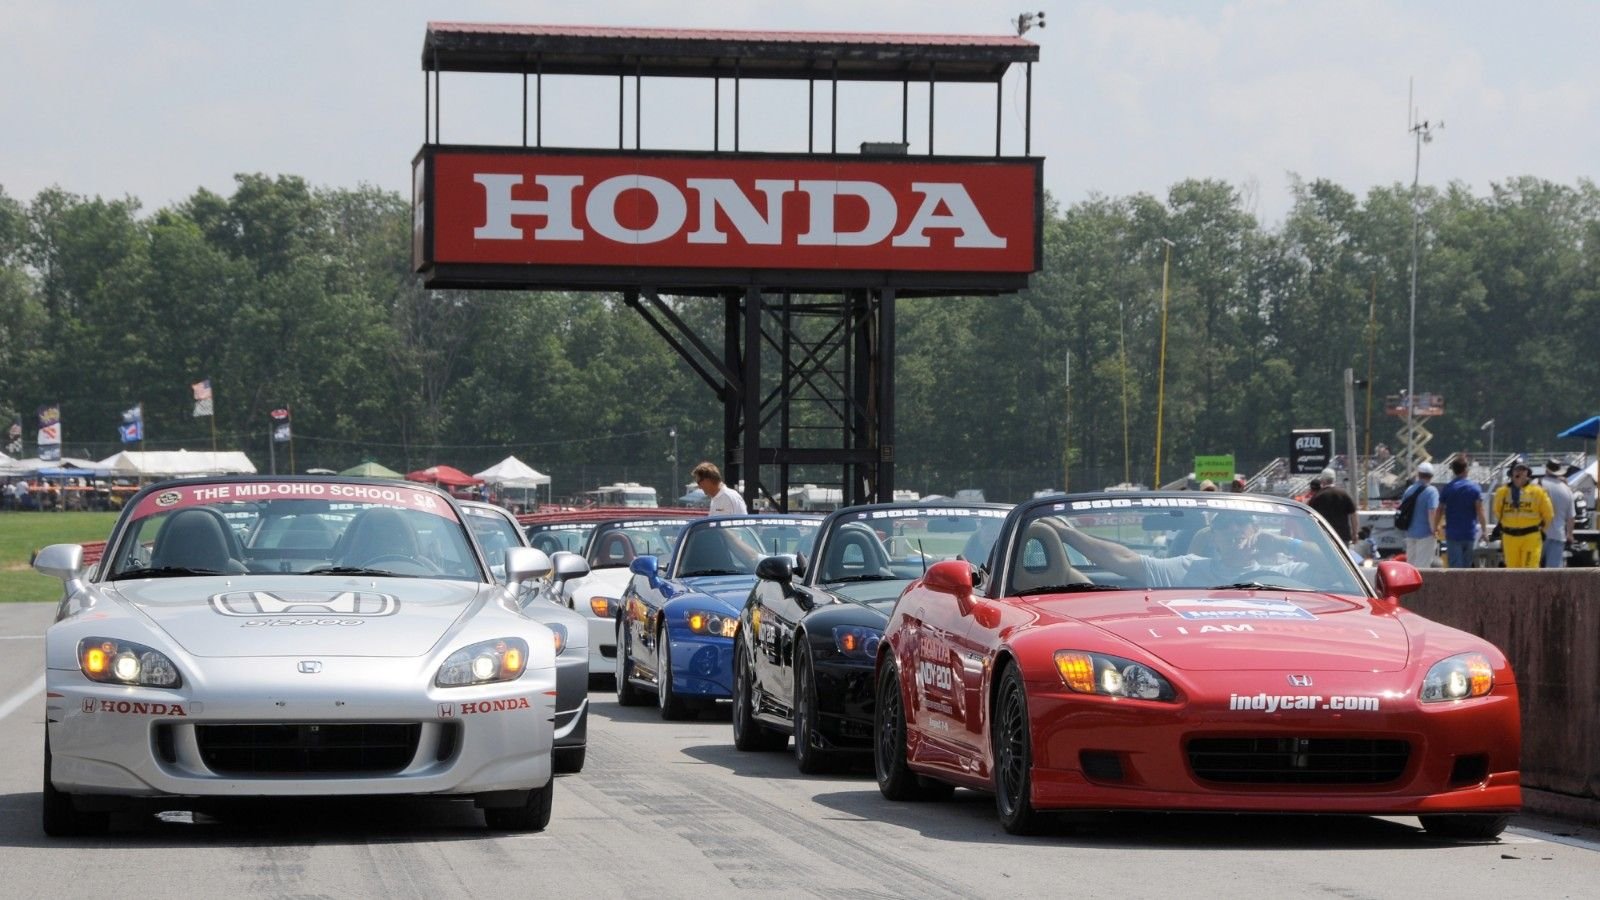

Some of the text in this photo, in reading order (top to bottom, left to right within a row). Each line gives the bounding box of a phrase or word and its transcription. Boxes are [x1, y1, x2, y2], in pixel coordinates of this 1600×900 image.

[473, 172, 1008, 250] HONDA
[1295, 436, 1324, 450] AZUL
[193, 486, 230, 501] THE
[235, 484, 325, 498] MID-OHIO
[329, 485, 406, 503] SCHOOL
[1199, 623, 1255, 634] AM
[936, 665, 952, 690] 200
[101, 700, 187, 717] HONDA
[461, 696, 531, 715] HONDA
